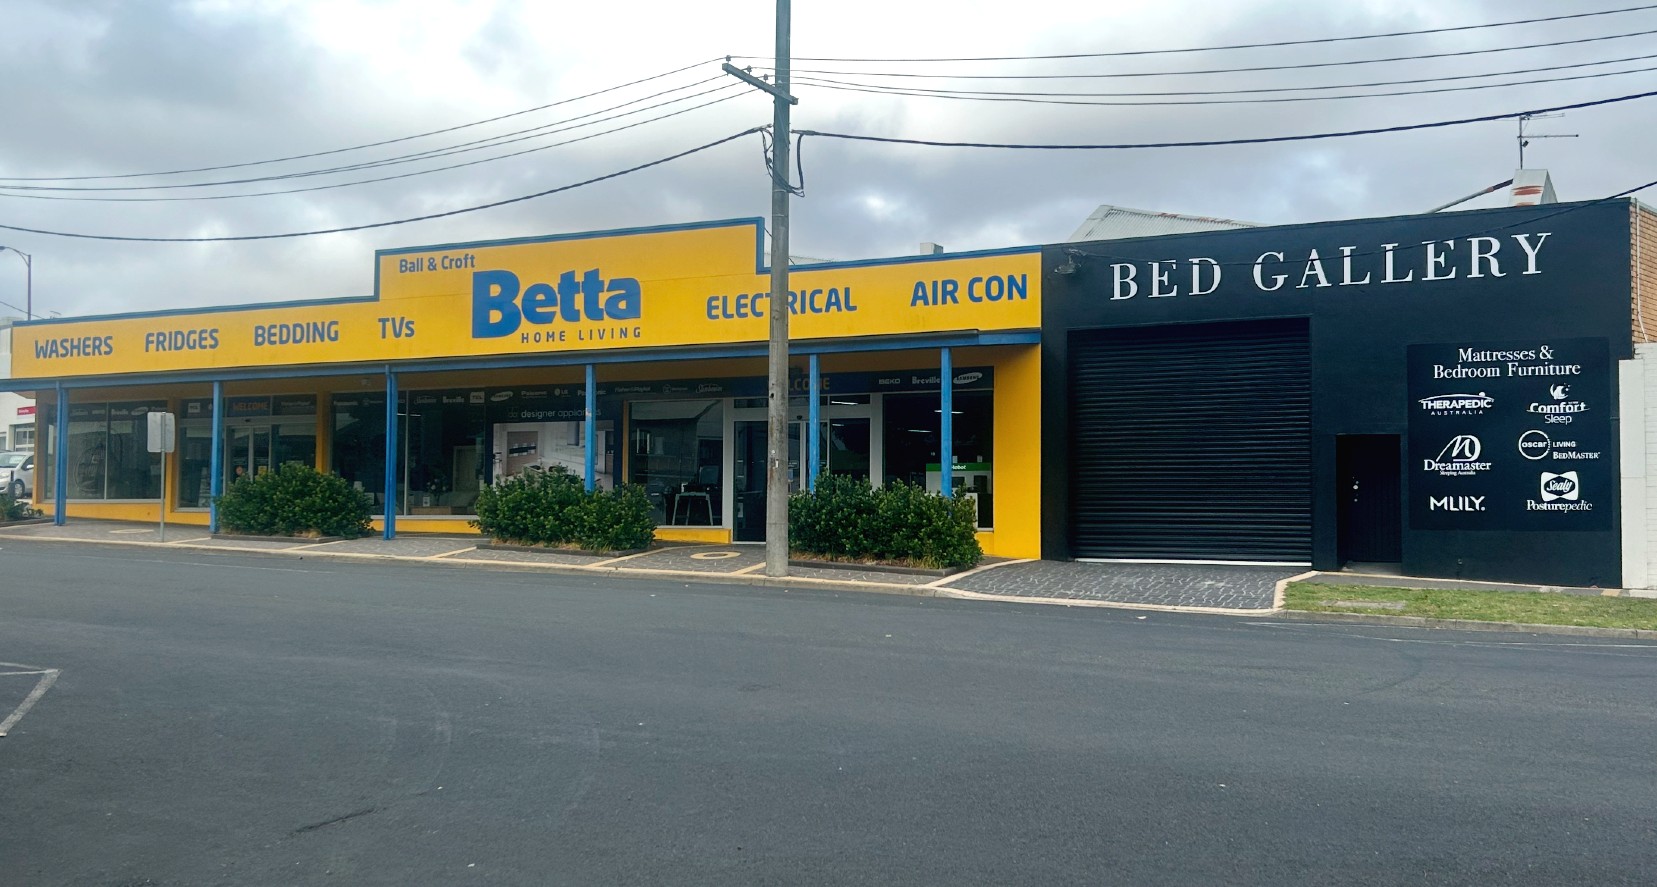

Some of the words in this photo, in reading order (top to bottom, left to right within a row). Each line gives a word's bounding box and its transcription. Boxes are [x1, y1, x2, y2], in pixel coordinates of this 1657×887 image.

[399, 258, 424, 273] Ball
[427, 257, 437, 271] &
[441, 253, 476, 270] Croft
[1109, 257, 1222, 301] BED
[1252, 232, 1552, 292] GALLERY
[911, 276, 958, 307] AIR
[967, 273, 1029, 304] CON
[471, 268, 642, 339] Betta
[253, 320, 340, 347] BEDDING
[378, 316, 415, 339] TVs
[521, 330, 566, 344] HOME
[578, 326, 641, 341] LIVING
[34, 335, 114, 360] WASHERS
[144, 328, 220, 353] FRIDGES
[1458, 348, 1536, 363] Mattresses
[1539, 345, 1554, 360] &
[1433, 364, 1501, 379] Bedroom
[1507, 361, 1581, 377] Furniture
[1421, 399, 1493, 410] THERAPEDIC
[1529, 402, 1587, 414] Comfort
[520, 409, 556, 420] designer
[1544, 414, 1573, 425] Sleep
[1423, 459, 1492, 471] Dreamaster
[1546, 479, 1573, 493] Sealy
[1526, 499, 1593, 513] Posturepedic
